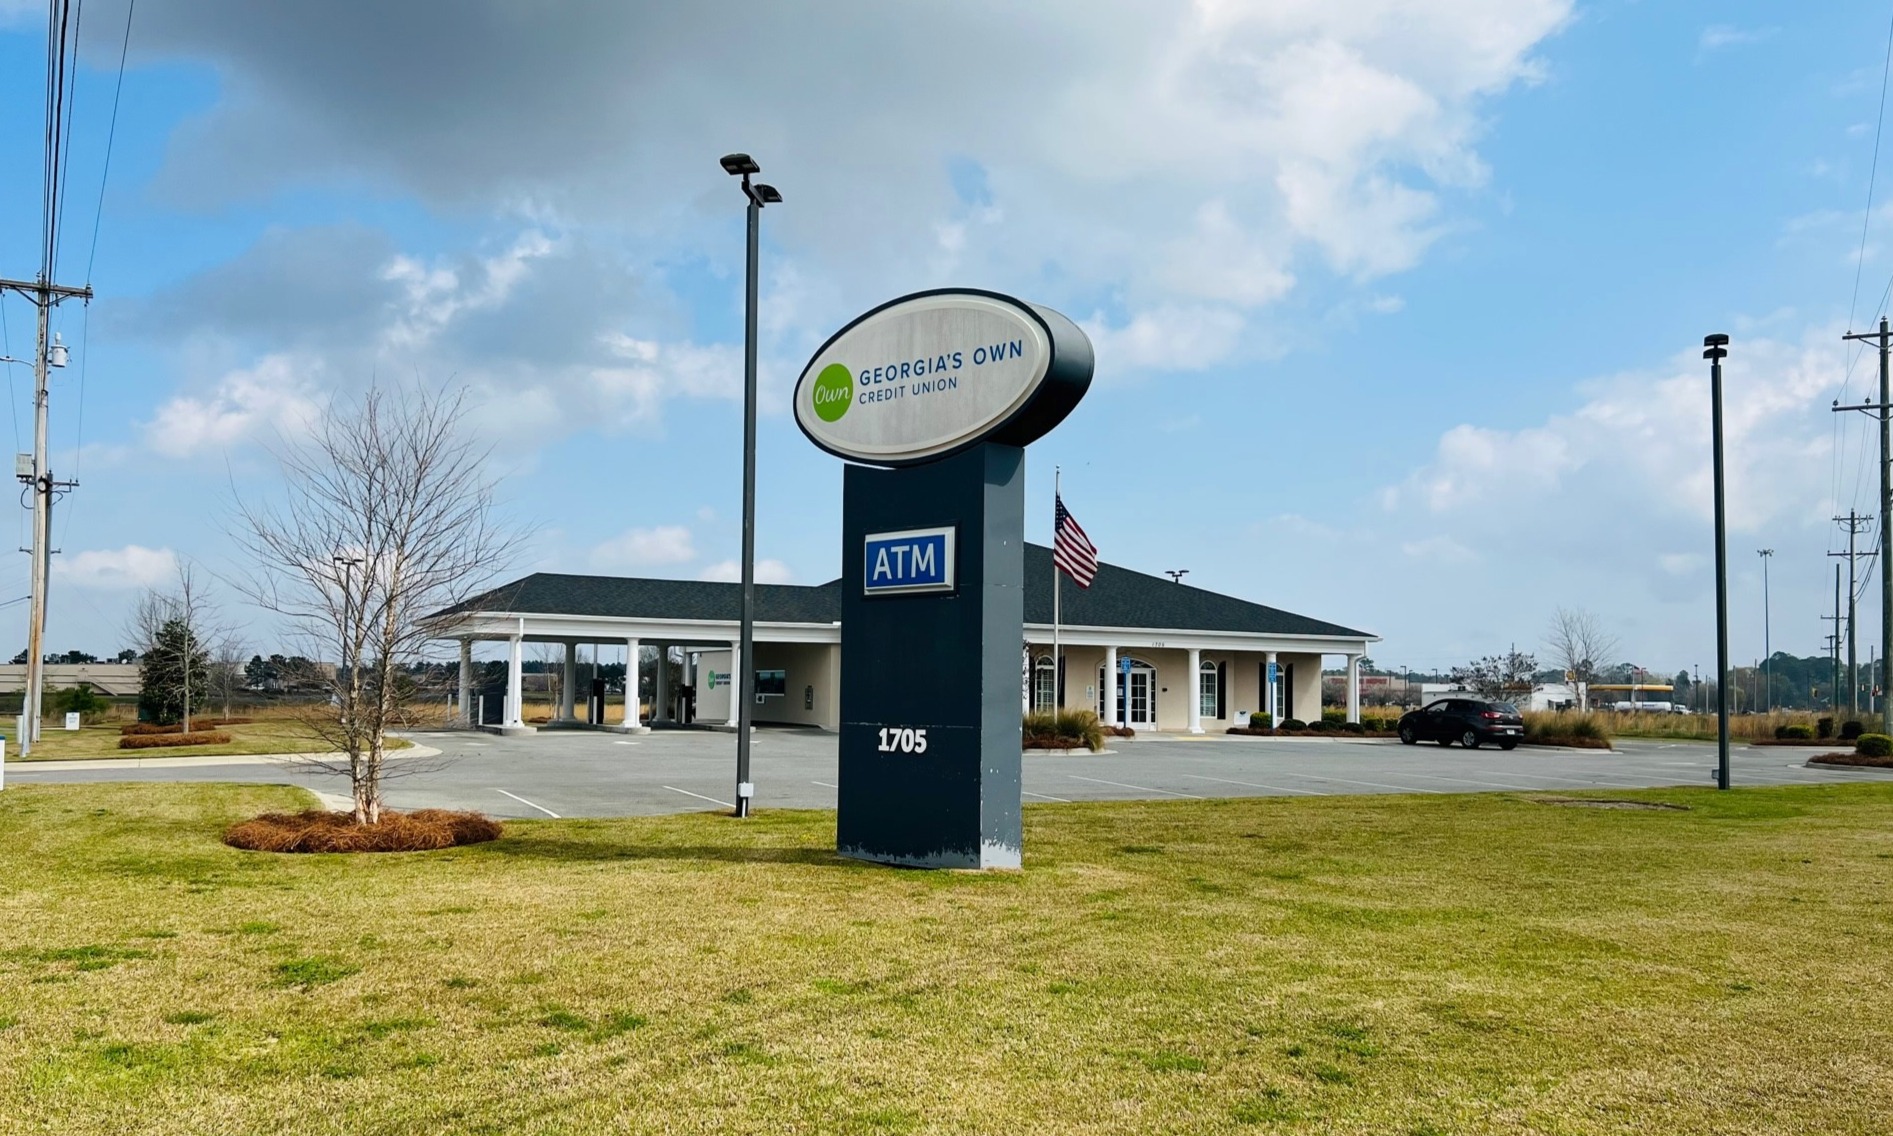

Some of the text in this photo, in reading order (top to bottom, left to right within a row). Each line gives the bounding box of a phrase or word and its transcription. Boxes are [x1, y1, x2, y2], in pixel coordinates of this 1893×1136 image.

[860, 339, 1022, 386] GEORGIA'S OWN
[815, 385, 851, 404] Own
[859, 377, 957, 405] CREDIT UNION
[873, 542, 935, 581] ATM
[878, 728, 927, 753] 1705
